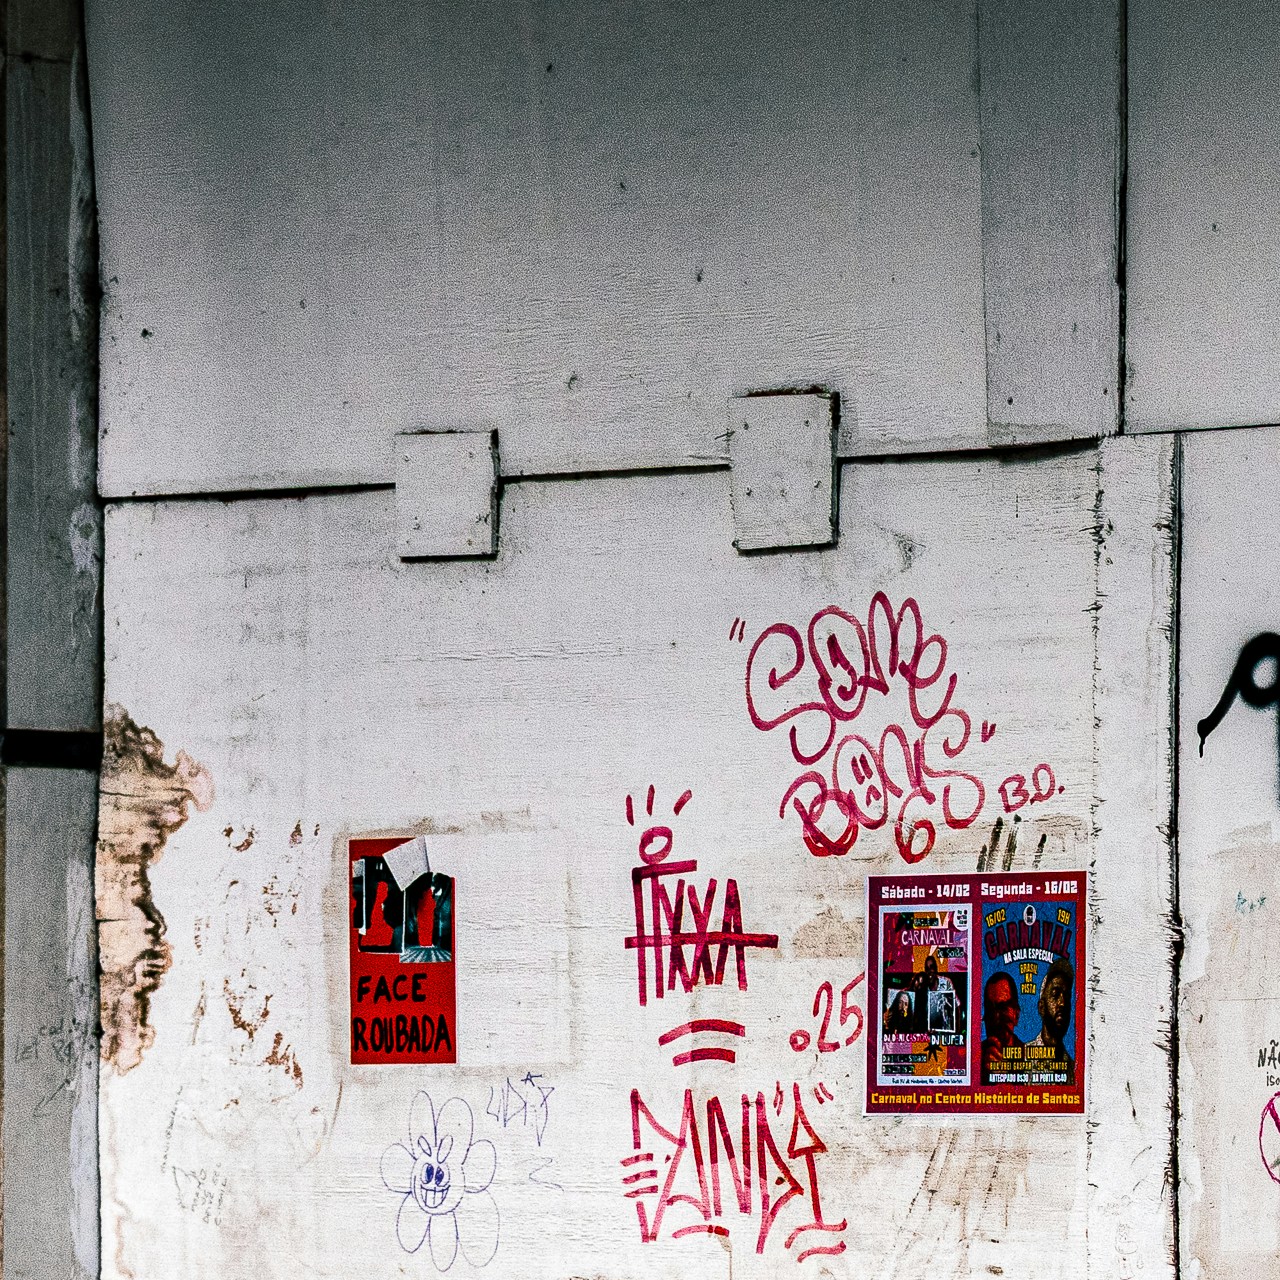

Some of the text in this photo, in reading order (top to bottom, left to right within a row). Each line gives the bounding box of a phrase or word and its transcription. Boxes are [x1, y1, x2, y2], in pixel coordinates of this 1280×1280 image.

[881, 880, 1078, 899] Sábado 14/02 Segunda 16/02
[985, 909, 1007, 928] 16/02
[901, 929, 953, 946] CARNAVAL
[984, 921, 1072, 961] CARNAVAL
[357, 973, 428, 1003] FACE
[351, 1011, 453, 1055] ROUBADA
[871, 1092, 1081, 1105] Carnaval no Centro Histórico de Santos
